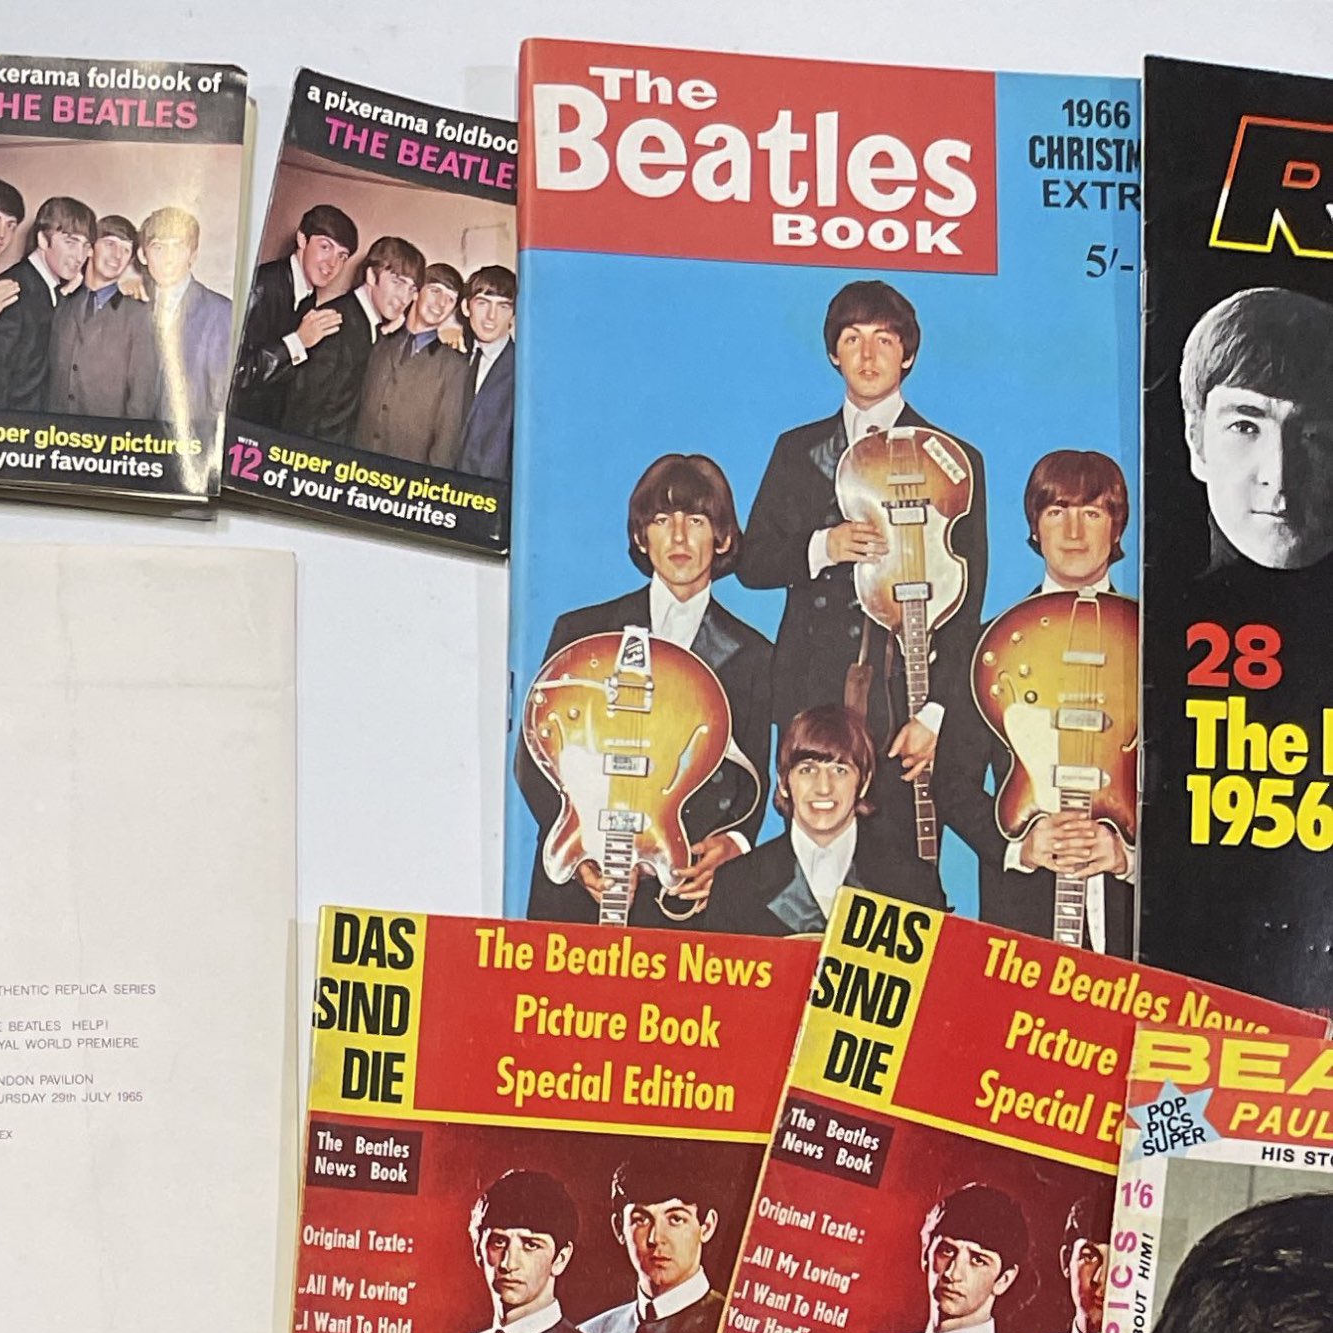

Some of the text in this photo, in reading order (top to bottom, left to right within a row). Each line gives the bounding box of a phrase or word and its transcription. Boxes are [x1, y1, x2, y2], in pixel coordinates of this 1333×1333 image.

[589, 66, 719, 110] The
[1062, 99, 1131, 130] 1966
[532, 83, 978, 217] Beatles
[771, 214, 964, 256] BOOK
[229, 444, 498, 515] 12 super glossy pictures
[262, 467, 457, 529] of your favourites
[1186, 621, 1283, 689] 28
[1186, 700, 1307, 776] The
[332, 913, 416, 970] DAS
[475, 929, 773, 988] The Beatles News
[55, 984, 107, 995] REPLICA
[113, 984, 156, 995] SERIES
[312, 978, 411, 1037] SIND
[8, 1021, 61, 1032] BEATLES
[72, 1020, 108, 1031] HELP!
[25, 1039, 71, 1049] WORLD
[77, 1038, 139, 1048] PREMIERE
[514, 995, 721, 1049] Picture Book
[39, 1074, 94, 1085] PAVILION
[51, 1093, 76, 1103] 29th
[82, 1092, 111, 1103] JULY
[117, 1092, 143, 1102] 1965
[341, 1048, 406, 1104] DIE
[496, 1057, 736, 1112] Special Edition
[1146, 1096, 1188, 1121] POP
[1146, 1112, 1195, 1138] PICS
[316, 1131, 410, 1159] The Beatles
[1141, 1127, 1207, 1157] SUPER
[315, 1157, 408, 1183] News Book
[1137, 1232, 1155, 1280] HIM!
